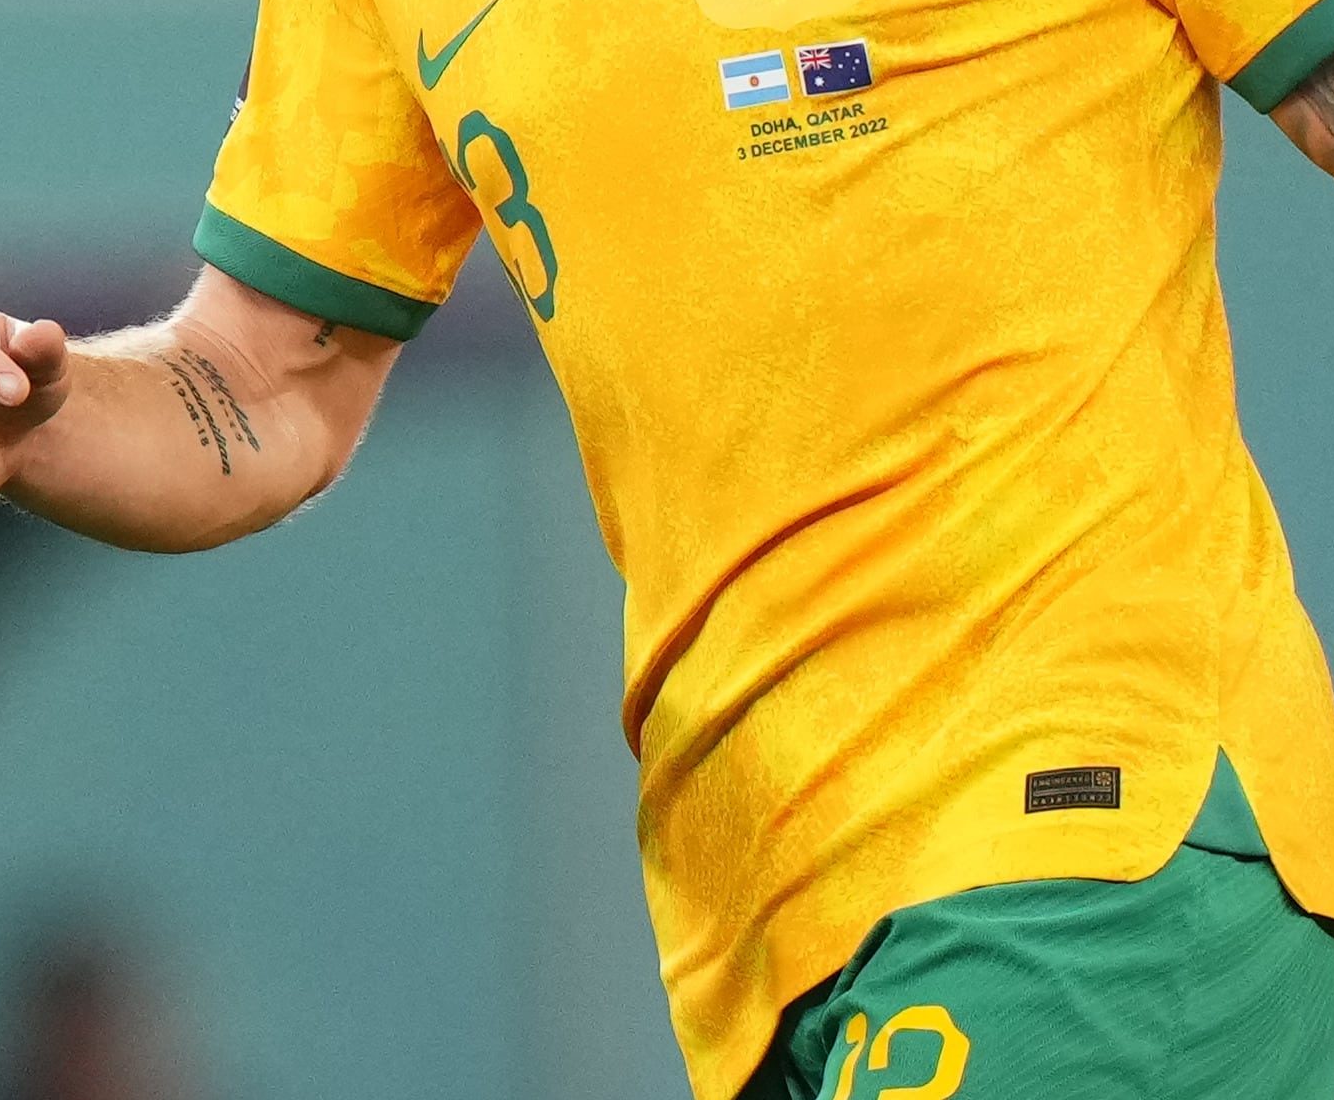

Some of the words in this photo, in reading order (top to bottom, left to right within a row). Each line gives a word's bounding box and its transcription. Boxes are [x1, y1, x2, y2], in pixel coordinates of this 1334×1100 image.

[737, 147, 747, 160] 3
[751, 128, 845, 157] DECEMBER
[849, 118, 889, 138] 2022
[750, 117, 802, 137] DOHA,
[806, 103, 865, 125] QATAR
[439, 109, 558, 323] 3
